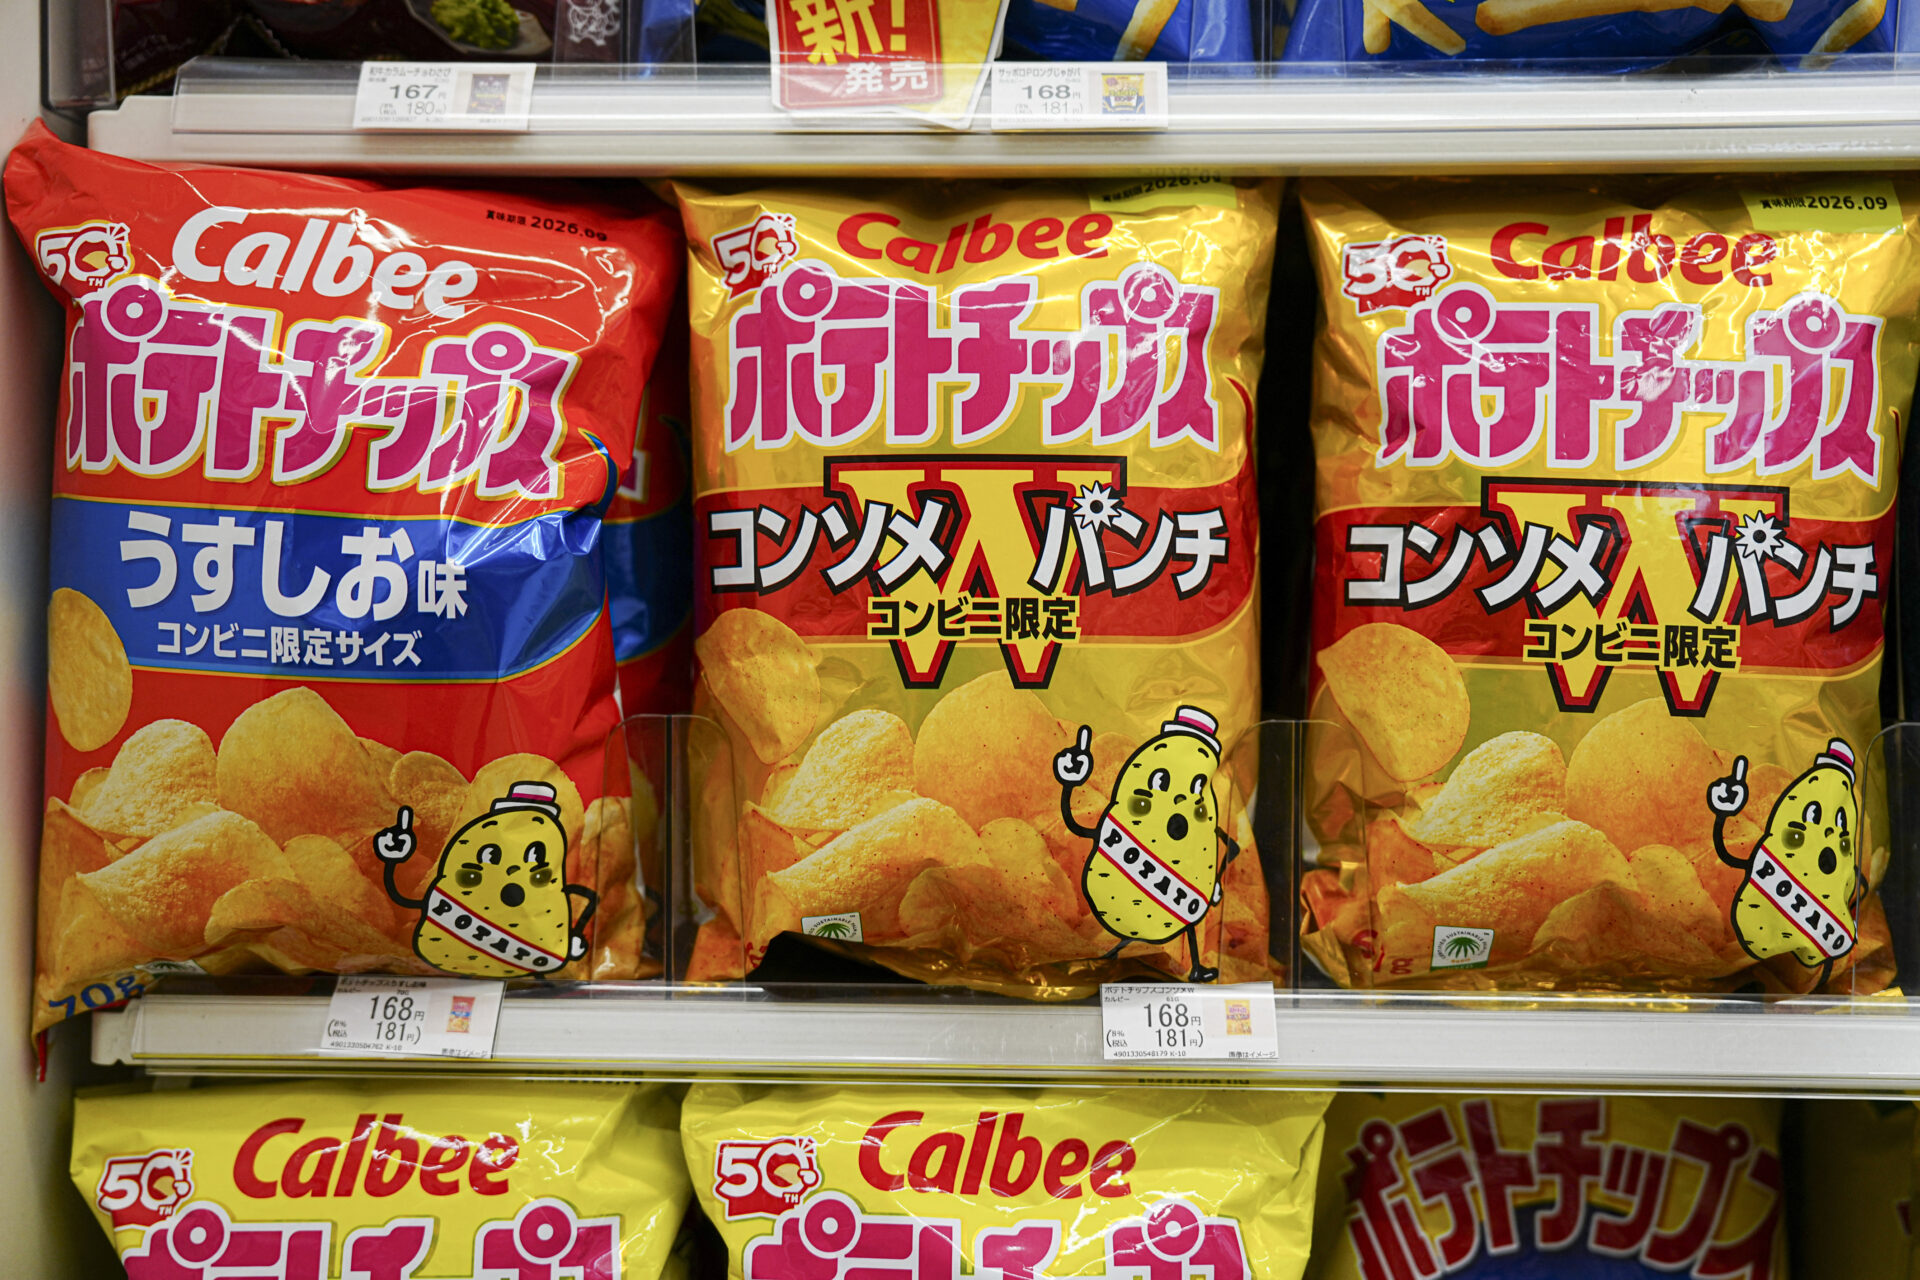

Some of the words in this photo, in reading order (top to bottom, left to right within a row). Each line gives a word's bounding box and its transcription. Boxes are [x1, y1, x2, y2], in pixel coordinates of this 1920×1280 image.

[790, 0, 908, 66] 新!
[845, 60, 929, 94] 発売
[171, 206, 479, 318] Calbee
[836, 212, 1113, 274] Calbee
[1490, 214, 1777, 287] Calbee
[67, 277, 579, 499] ポテトチップス
[726, 260, 1220, 452] ポテトチップス
[1376, 285, 1883, 486] ポテトチップス
[119, 512, 469, 621] うすしお味
[157, 622, 423, 667] コンビニ限定サイズ
[869, 597, 1078, 641] コンビニ限定
[1525, 620, 1740, 669] コンビニ限定
[1103, 828, 1200, 915] POTATO
[1756, 860, 1845, 950] POTATO
[432, 899, 549, 967] POTATO
[49, 975, 146, 1019] 70g
[370, 995, 425, 1021] 168円
[1143, 1003, 1202, 1027] 168円
[233, 1112, 521, 1200] Calbee
[858, 1110, 1137, 1200] Calbee
